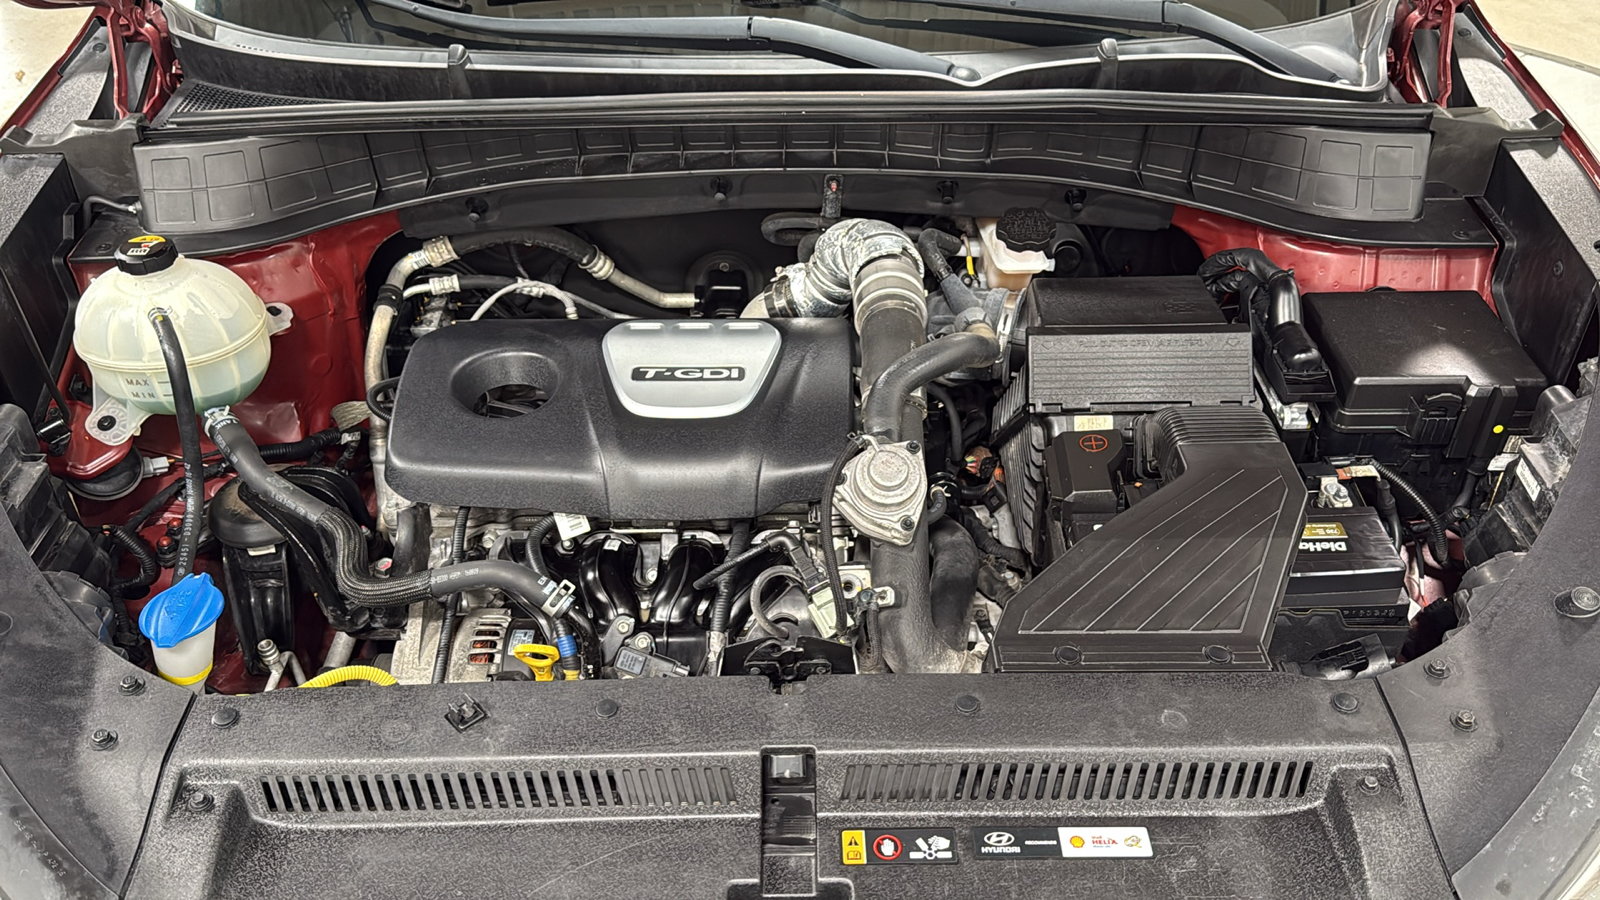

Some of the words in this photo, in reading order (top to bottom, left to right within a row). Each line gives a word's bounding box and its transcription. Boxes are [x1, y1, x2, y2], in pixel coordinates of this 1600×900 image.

[639, 368, 739, 379] T-GDI
[125, 378, 150, 386] MAX
[1299, 541, 1347, 552] DieHa
[178, 544, 190, 566] 25451
